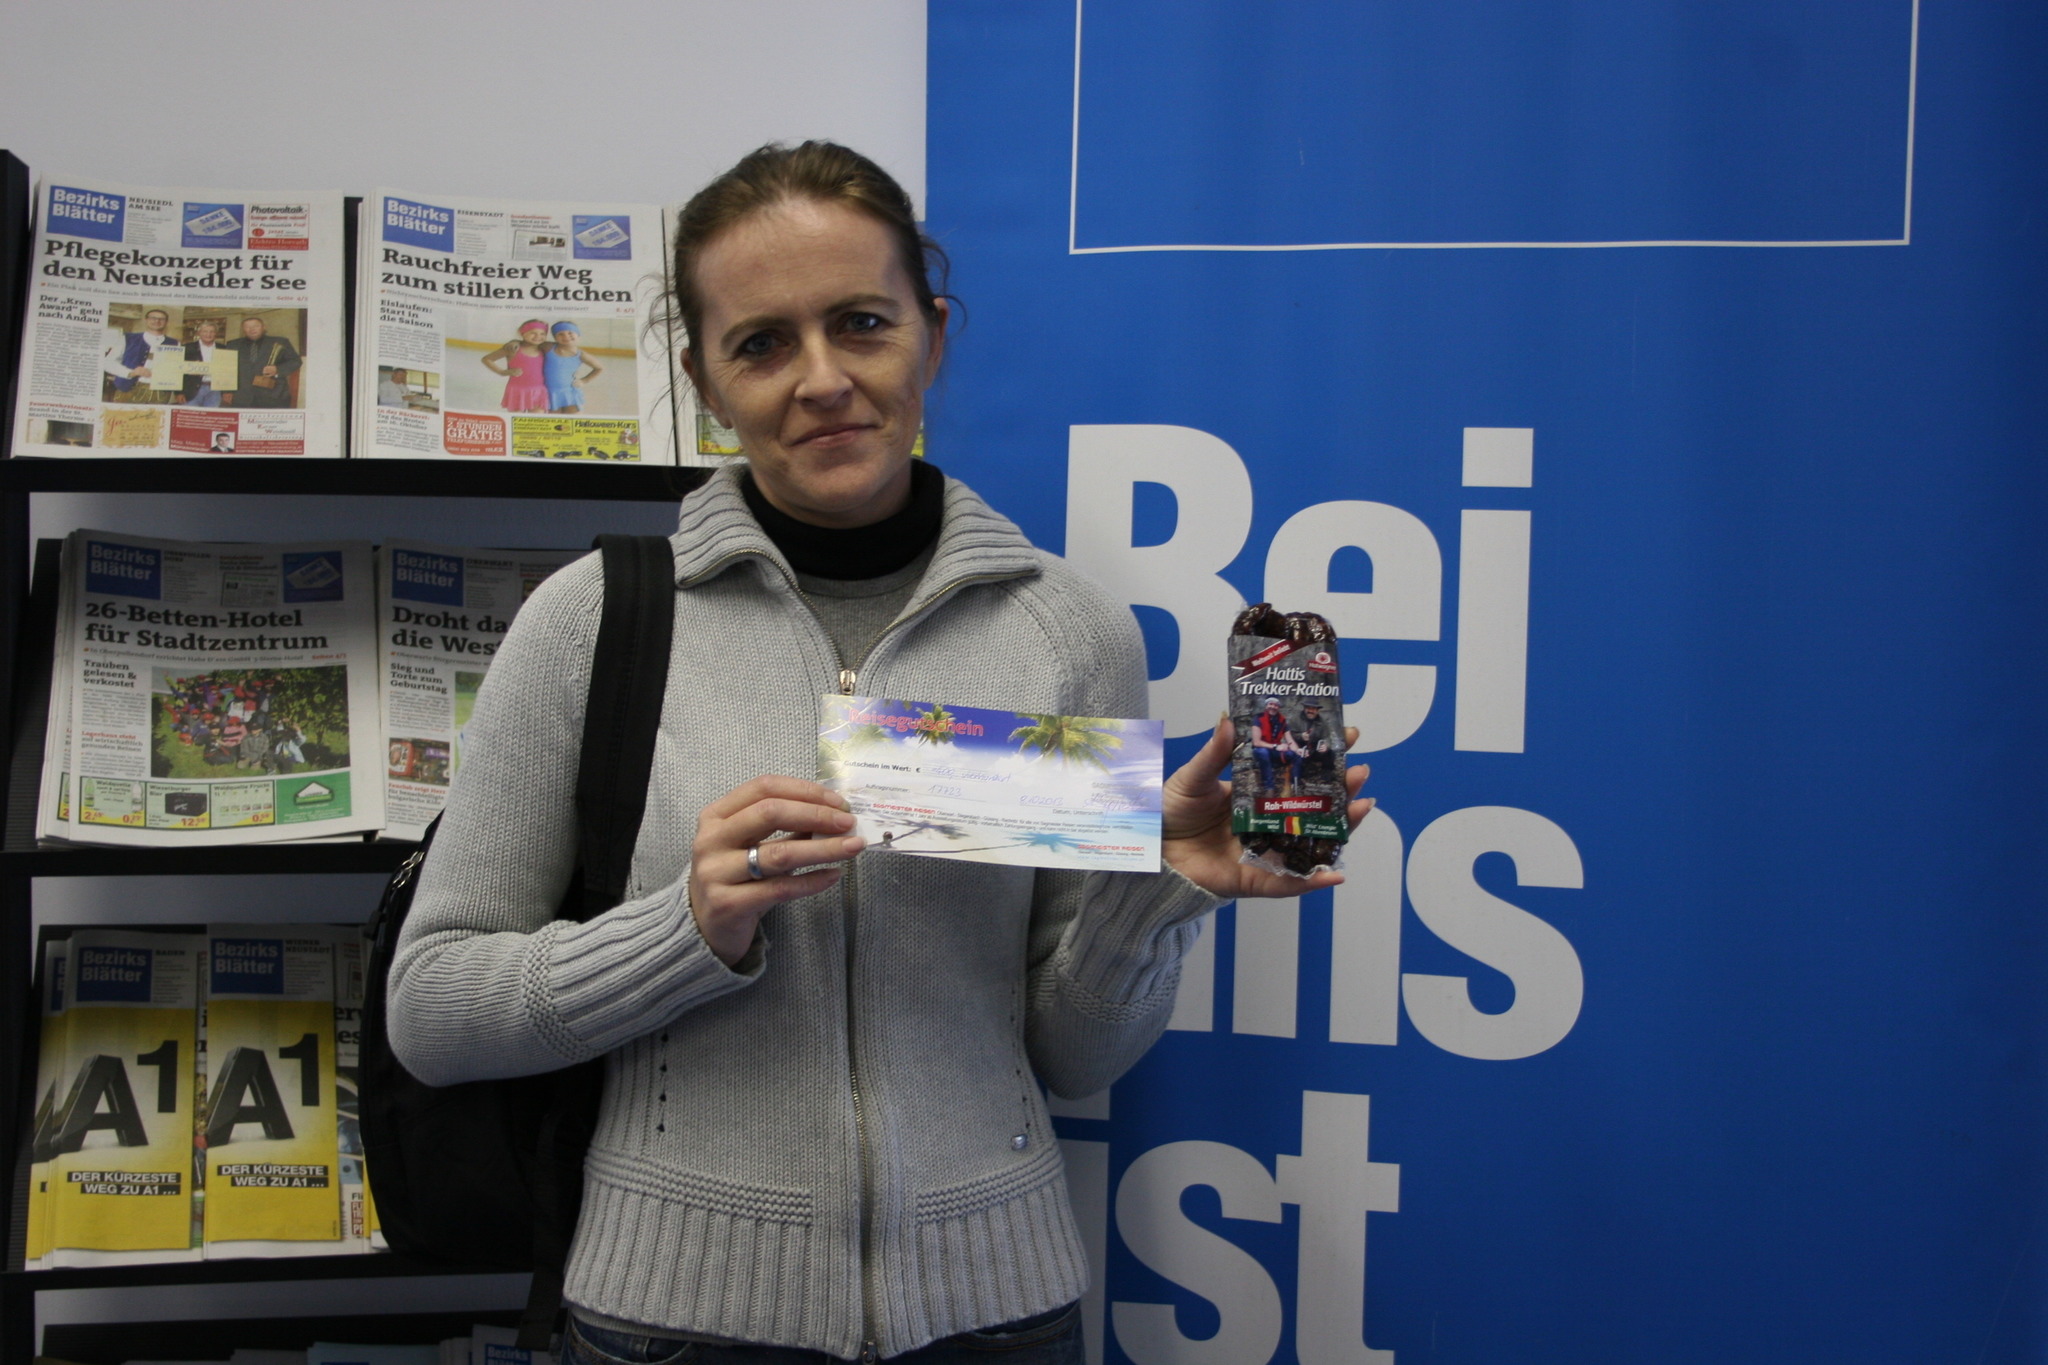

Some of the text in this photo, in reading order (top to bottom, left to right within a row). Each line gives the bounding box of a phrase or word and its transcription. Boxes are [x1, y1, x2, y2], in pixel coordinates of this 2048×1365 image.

[54, 188, 120, 210] Bezirks
[52, 203, 116, 224] Blätter
[251, 206, 303, 214] Photovoltaik
[387, 200, 449, 222] Bezirks
[386, 214, 446, 236] Blätter
[45, 240, 242, 273] Pflegekonzept
[250, 255, 293, 270] für
[43, 260, 306, 290] den Neusiedler See
[382, 248, 592, 286] Rauchfreier Weg
[382, 272, 632, 302] zum stillen Örtchen
[40, 294, 59, 302] Der
[80, 306, 103, 316] geht
[380, 307, 418, 318] Start in
[381, 299, 432, 314] Eislaufen:
[38, 311, 100, 324] nach Andau
[380, 314, 434, 328] die Saison
[446, 428, 503, 440] GRATIS
[456, 422, 502, 432] STUNDEN
[90, 545, 156, 566] Bezirks
[396, 552, 458, 574] Bezirks
[90, 559, 152, 580] Blätter
[396, 568, 455, 588] Blätter
[1065, 424, 1534, 755] Bei
[86, 601, 303, 628] 26-Betten-Hotel
[392, 606, 511, 633] Droht da
[85, 623, 328, 652] für Stadtzentrum
[391, 628, 502, 656] die Wes
[84, 659, 130, 670] Trauben
[390, 663, 412, 674] Sieg
[83, 668, 136, 680] gelesen &
[390, 671, 442, 684] Torte zum
[1266, 666, 1306, 681] Hattis
[84, 678, 134, 688] verkostet
[390, 680, 448, 694] Geburtstag
[1240, 682, 1340, 696] Trekker-Ration
[850, 708, 984, 738] Reisegutschein
[844, 760, 880, 770] Gutschein
[892, 764, 912, 772] Wert:
[1264, 800, 1323, 810] Roh-Wildwürstel
[82, 950, 146, 966] Bezirks
[215, 942, 278, 958] Bezirks
[82, 965, 142, 982] Blätter
[215, 958, 274, 974] Blätter
[53, 1040, 178, 1153] A1
[207, 1033, 320, 1149] A1
[72, 1170, 177, 1184] DER KÜRZESTE
[222, 1162, 324, 1176] DER KÜRZESTE
[84, 1184, 118, 1195] WEG
[120, 1184, 140, 1195] ZU
[142, 1184, 160, 1195] A1
[234, 1176, 269, 1187] WEG
[272, 1176, 290, 1186] ZU
[292, 1176, 308, 1186] A1
[1047, 1083, 1399, 1365] ist
[488, 1346, 528, 1360] Bezirks
